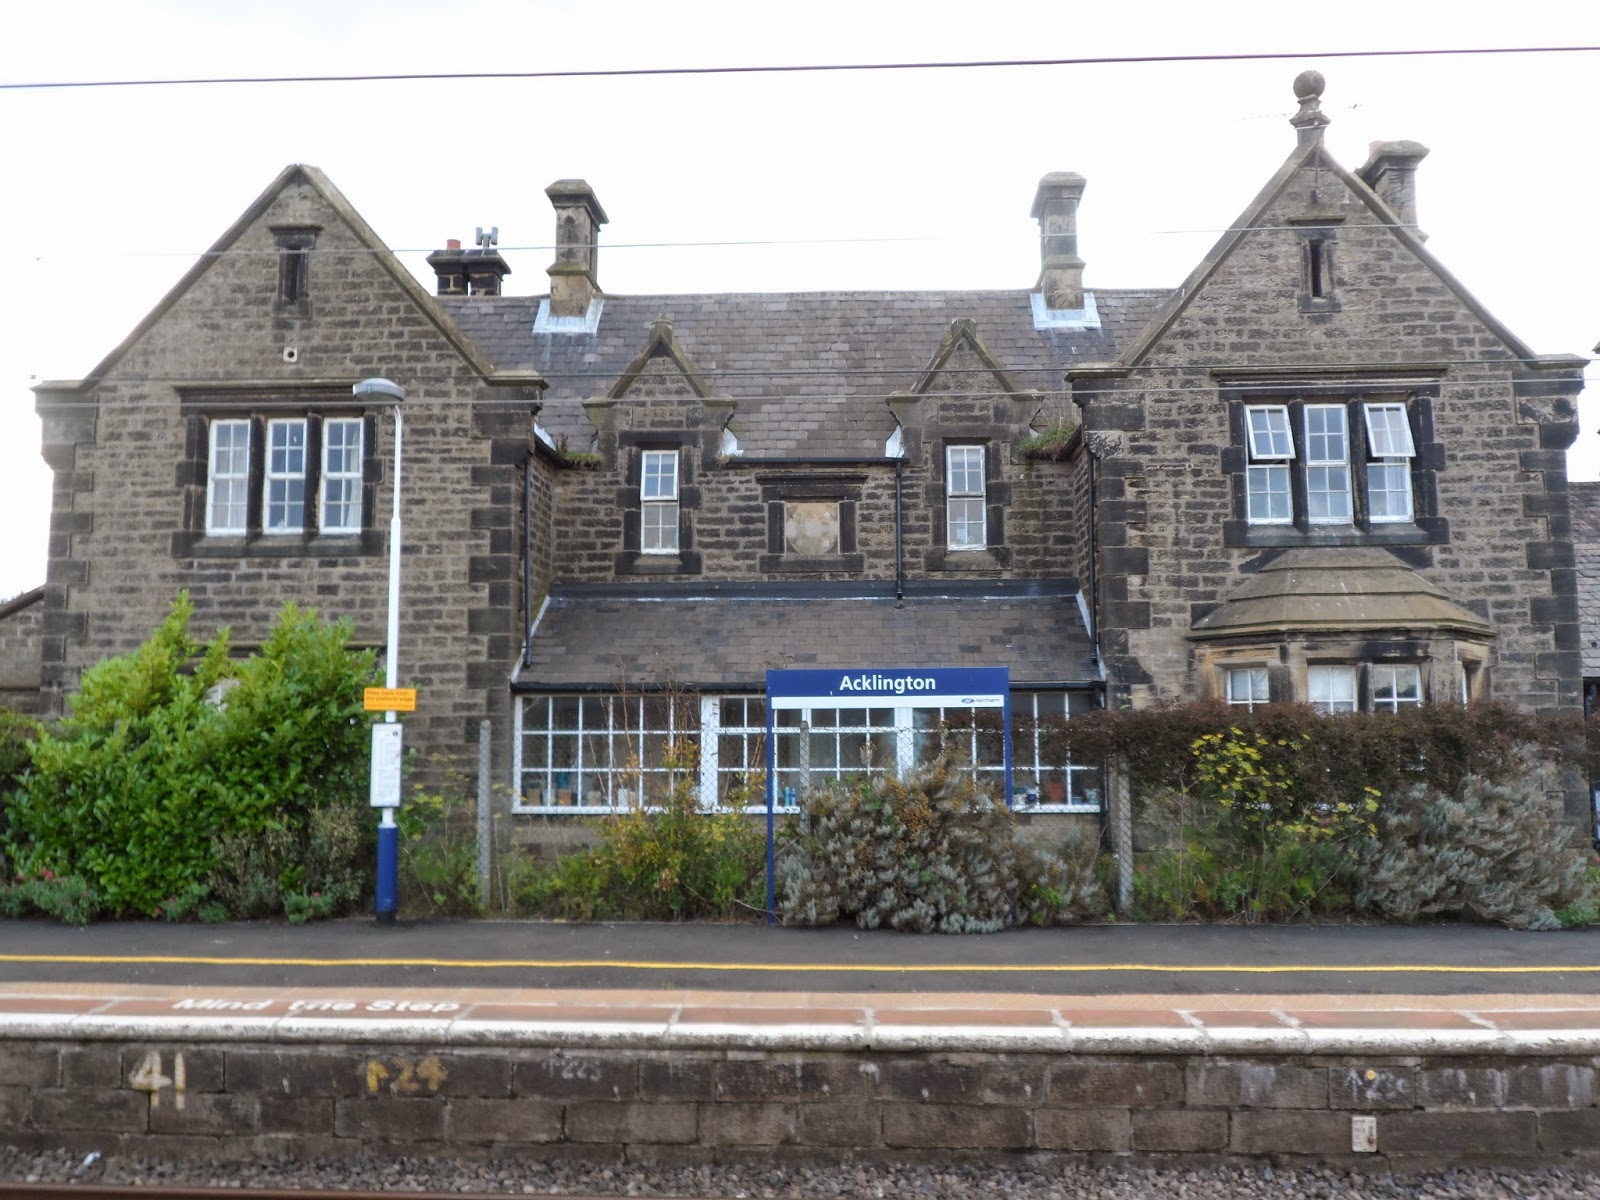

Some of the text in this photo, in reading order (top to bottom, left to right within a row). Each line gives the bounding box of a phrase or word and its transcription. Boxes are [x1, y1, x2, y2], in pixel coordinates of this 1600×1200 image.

[839, 674, 936, 694] Acklington
[171, 999, 272, 1010] Mind
[366, 1000, 460, 1013] Step
[128, 1051, 186, 1110] 41
